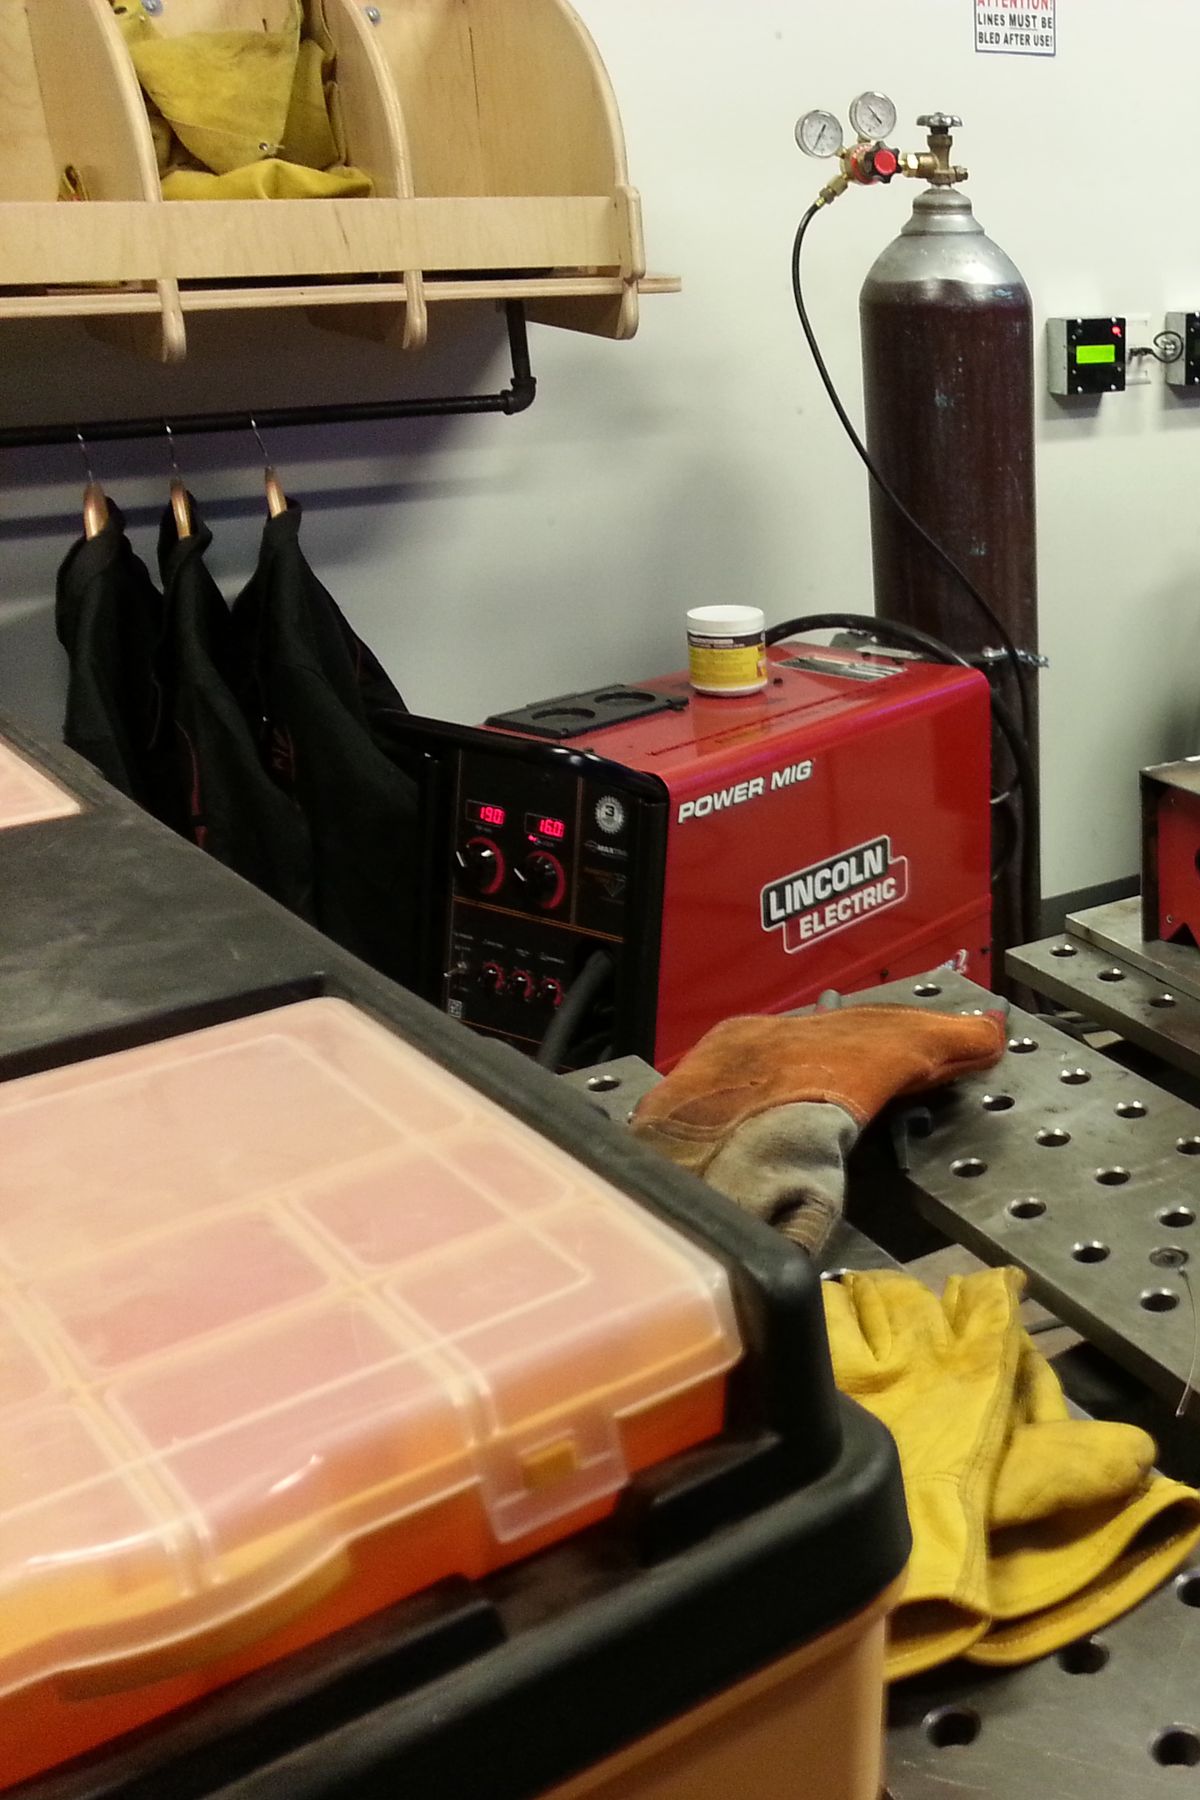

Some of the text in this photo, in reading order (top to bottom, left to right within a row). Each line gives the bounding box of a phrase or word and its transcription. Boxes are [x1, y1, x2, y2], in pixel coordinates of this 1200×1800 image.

[977, 13, 1052, 29] LINES MUST BE
[978, 31, 1000, 44] BLED
[1003, 32, 1031, 46] AFTER
[678, 759, 813, 824] POWER MIG
[768, 845, 883, 922] LINCOLN
[799, 877, 896, 940] ELECTRIC
